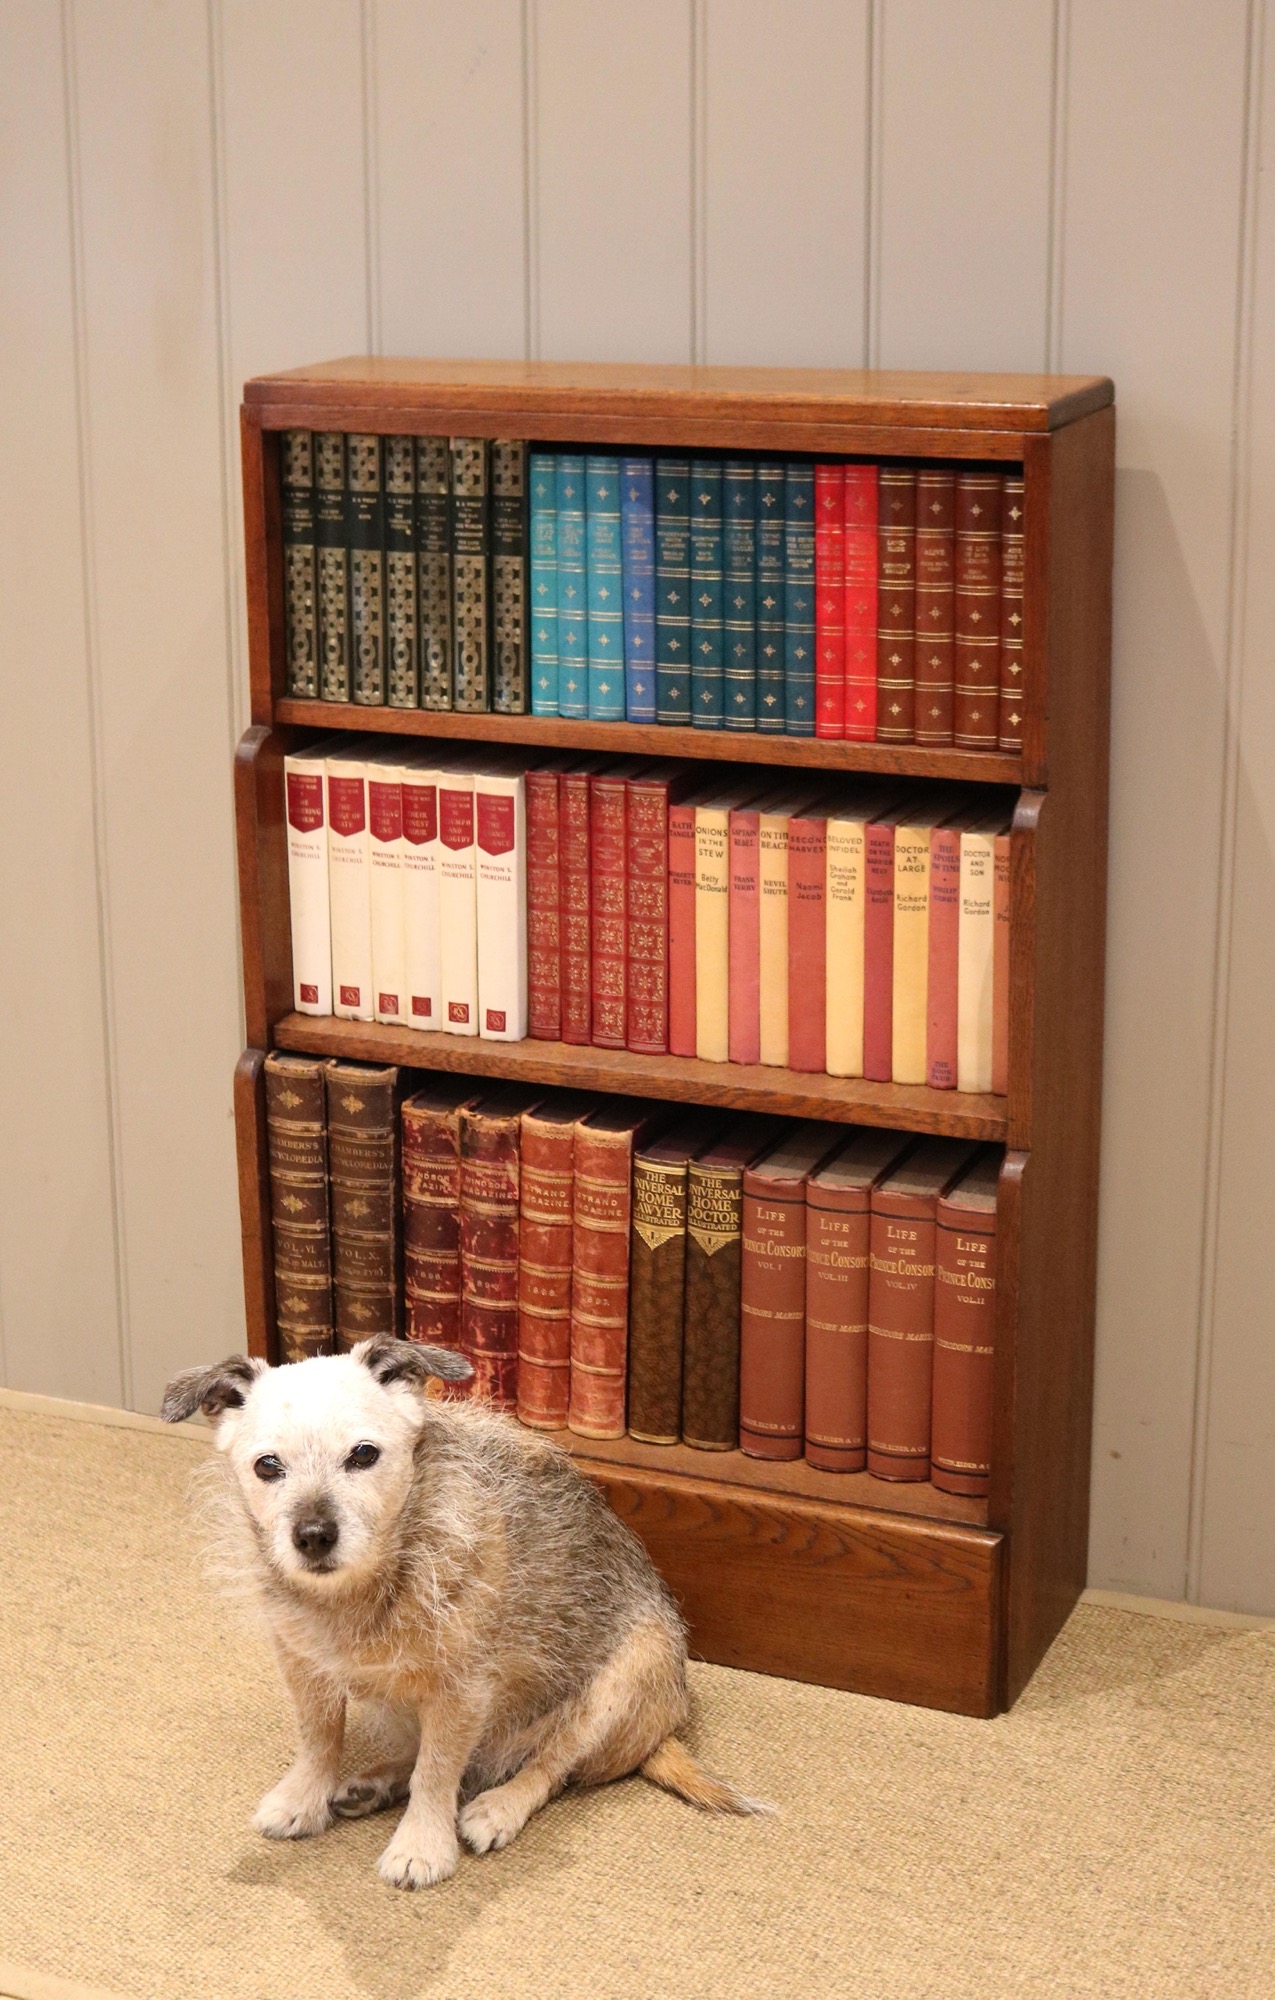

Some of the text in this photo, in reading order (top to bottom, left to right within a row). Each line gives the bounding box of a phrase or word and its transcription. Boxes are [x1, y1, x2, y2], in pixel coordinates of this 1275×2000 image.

[695, 827, 728, 837] ONIONS
[708, 839, 723, 847] THE
[828, 836, 863, 845] BELOVED
[699, 848, 724, 858] STEW
[829, 845, 860, 854] INFIDEL
[896, 846, 929, 854] DOCTOR
[939, 845, 953, 853] THE
[964, 850, 991, 858] DOCTOR
[829, 865, 857, 874] Sheilah
[898, 865, 926, 873] LARGE
[969, 869, 984, 877] SON
[701, 873, 719, 885] Betty
[829, 872, 857, 881] Graham
[695, 883, 728, 893] MacDonald
[763, 880, 786, 888] NEVIL
[796, 882, 823, 891] Naomi
[763, 887, 788, 895] SHUTE
[830, 886, 855, 895] Gerold
[796, 893, 822, 901] Jacob
[832, 892, 853, 901] Frank
[896, 894, 928, 903] Richard
[897, 904, 926, 912] Gordon
[963, 899, 990, 908] Richard
[646, 1171, 666, 1183] THE
[700, 1177, 723, 1189] THE
[524, 1184, 566, 1198] STRAND
[577, 1192, 618, 1206] STRAND
[637, 1190, 674, 1207] HOME
[693, 1196, 732, 1211] HOME
[688, 1206, 740, 1224] DOCTOR
[757, 1207, 786, 1222] LIFE
[820, 1218, 850, 1232] LIFE
[757, 1227, 785, 1237] OF THE
[888, 1226, 917, 1241] LIFE
[821, 1239, 849, 1248] OF THE
[957, 1238, 987, 1253] LIFE
[888, 1246, 916, 1256] OF THE
[957, 1259, 986, 1269] OF THE
